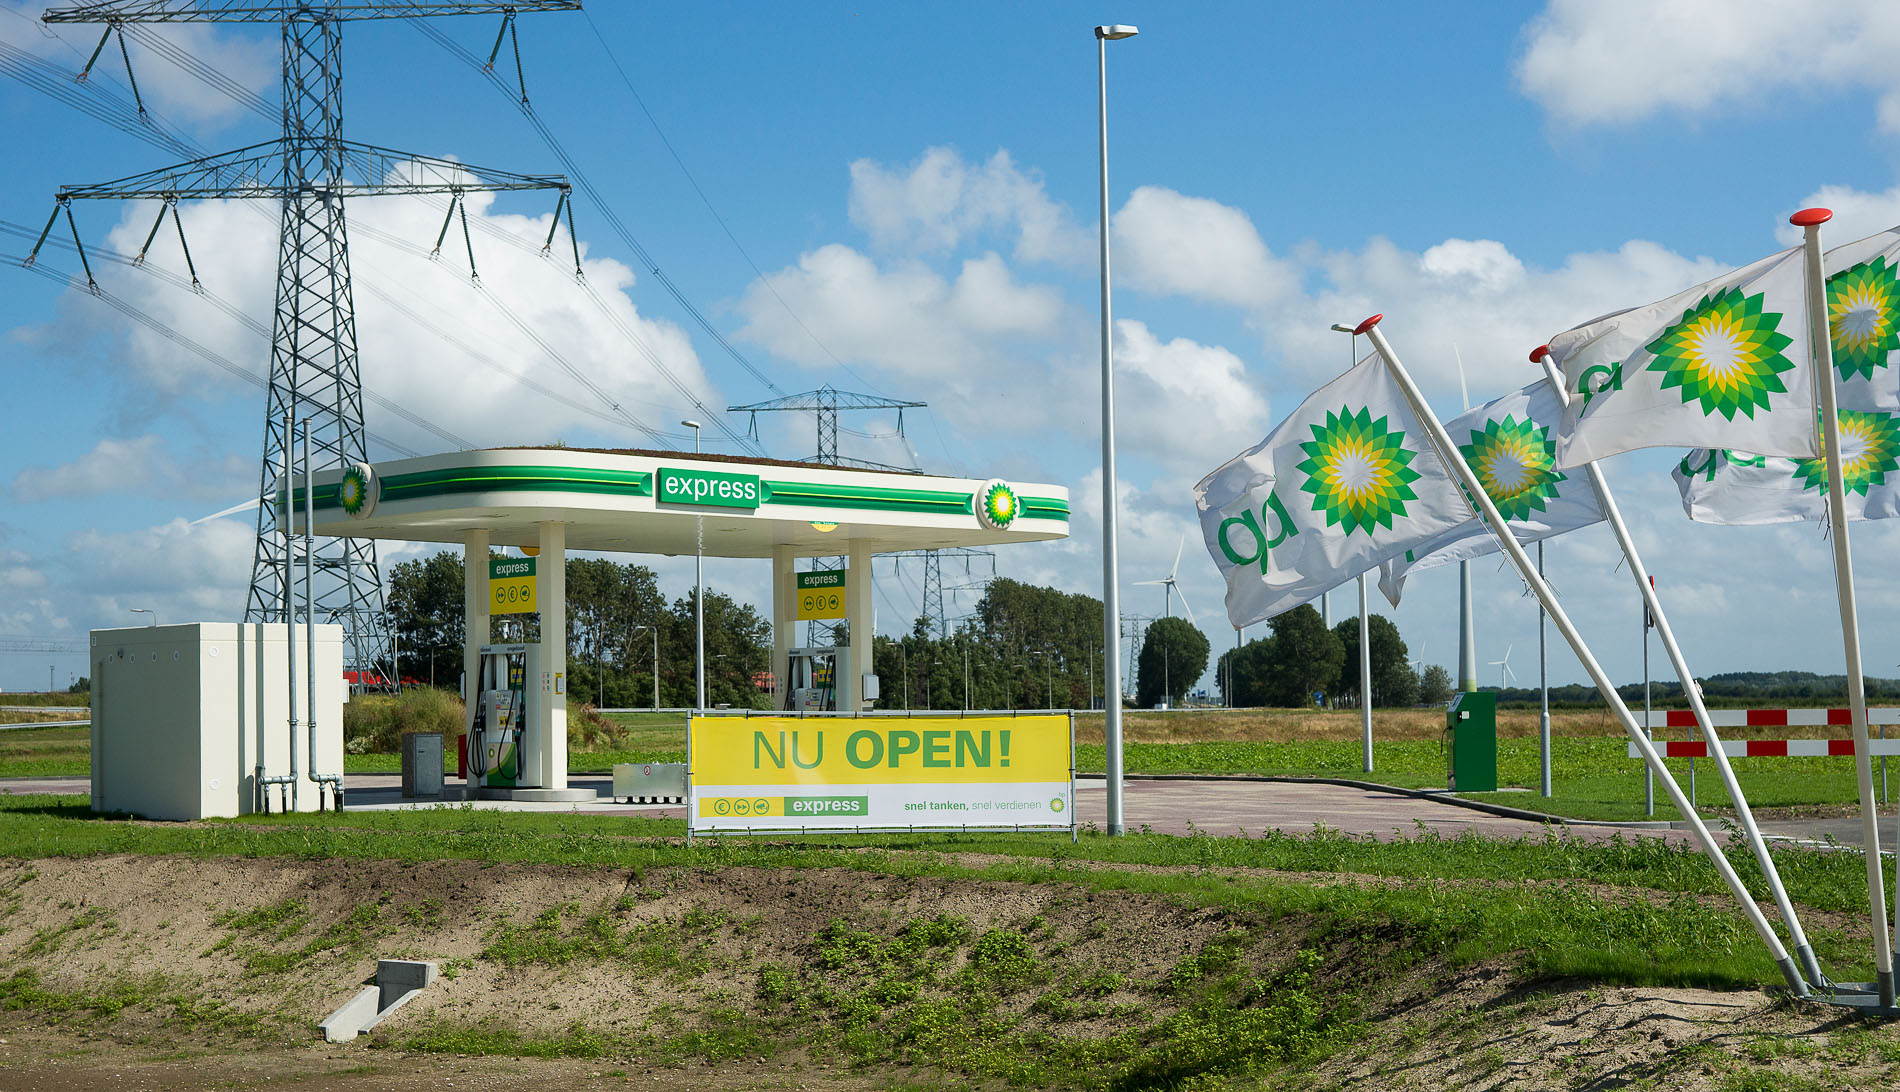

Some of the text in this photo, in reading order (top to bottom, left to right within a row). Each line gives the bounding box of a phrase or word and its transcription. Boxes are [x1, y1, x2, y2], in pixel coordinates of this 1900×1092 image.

[665, 476, 756, 502] express
[496, 563, 529, 576] express
[804, 574, 838, 587] express
[753, 730, 1011, 769] NU OPEN!
[793, 799, 860, 814] express
[904, 800, 1042, 812] snel tanken, snel verdienen
